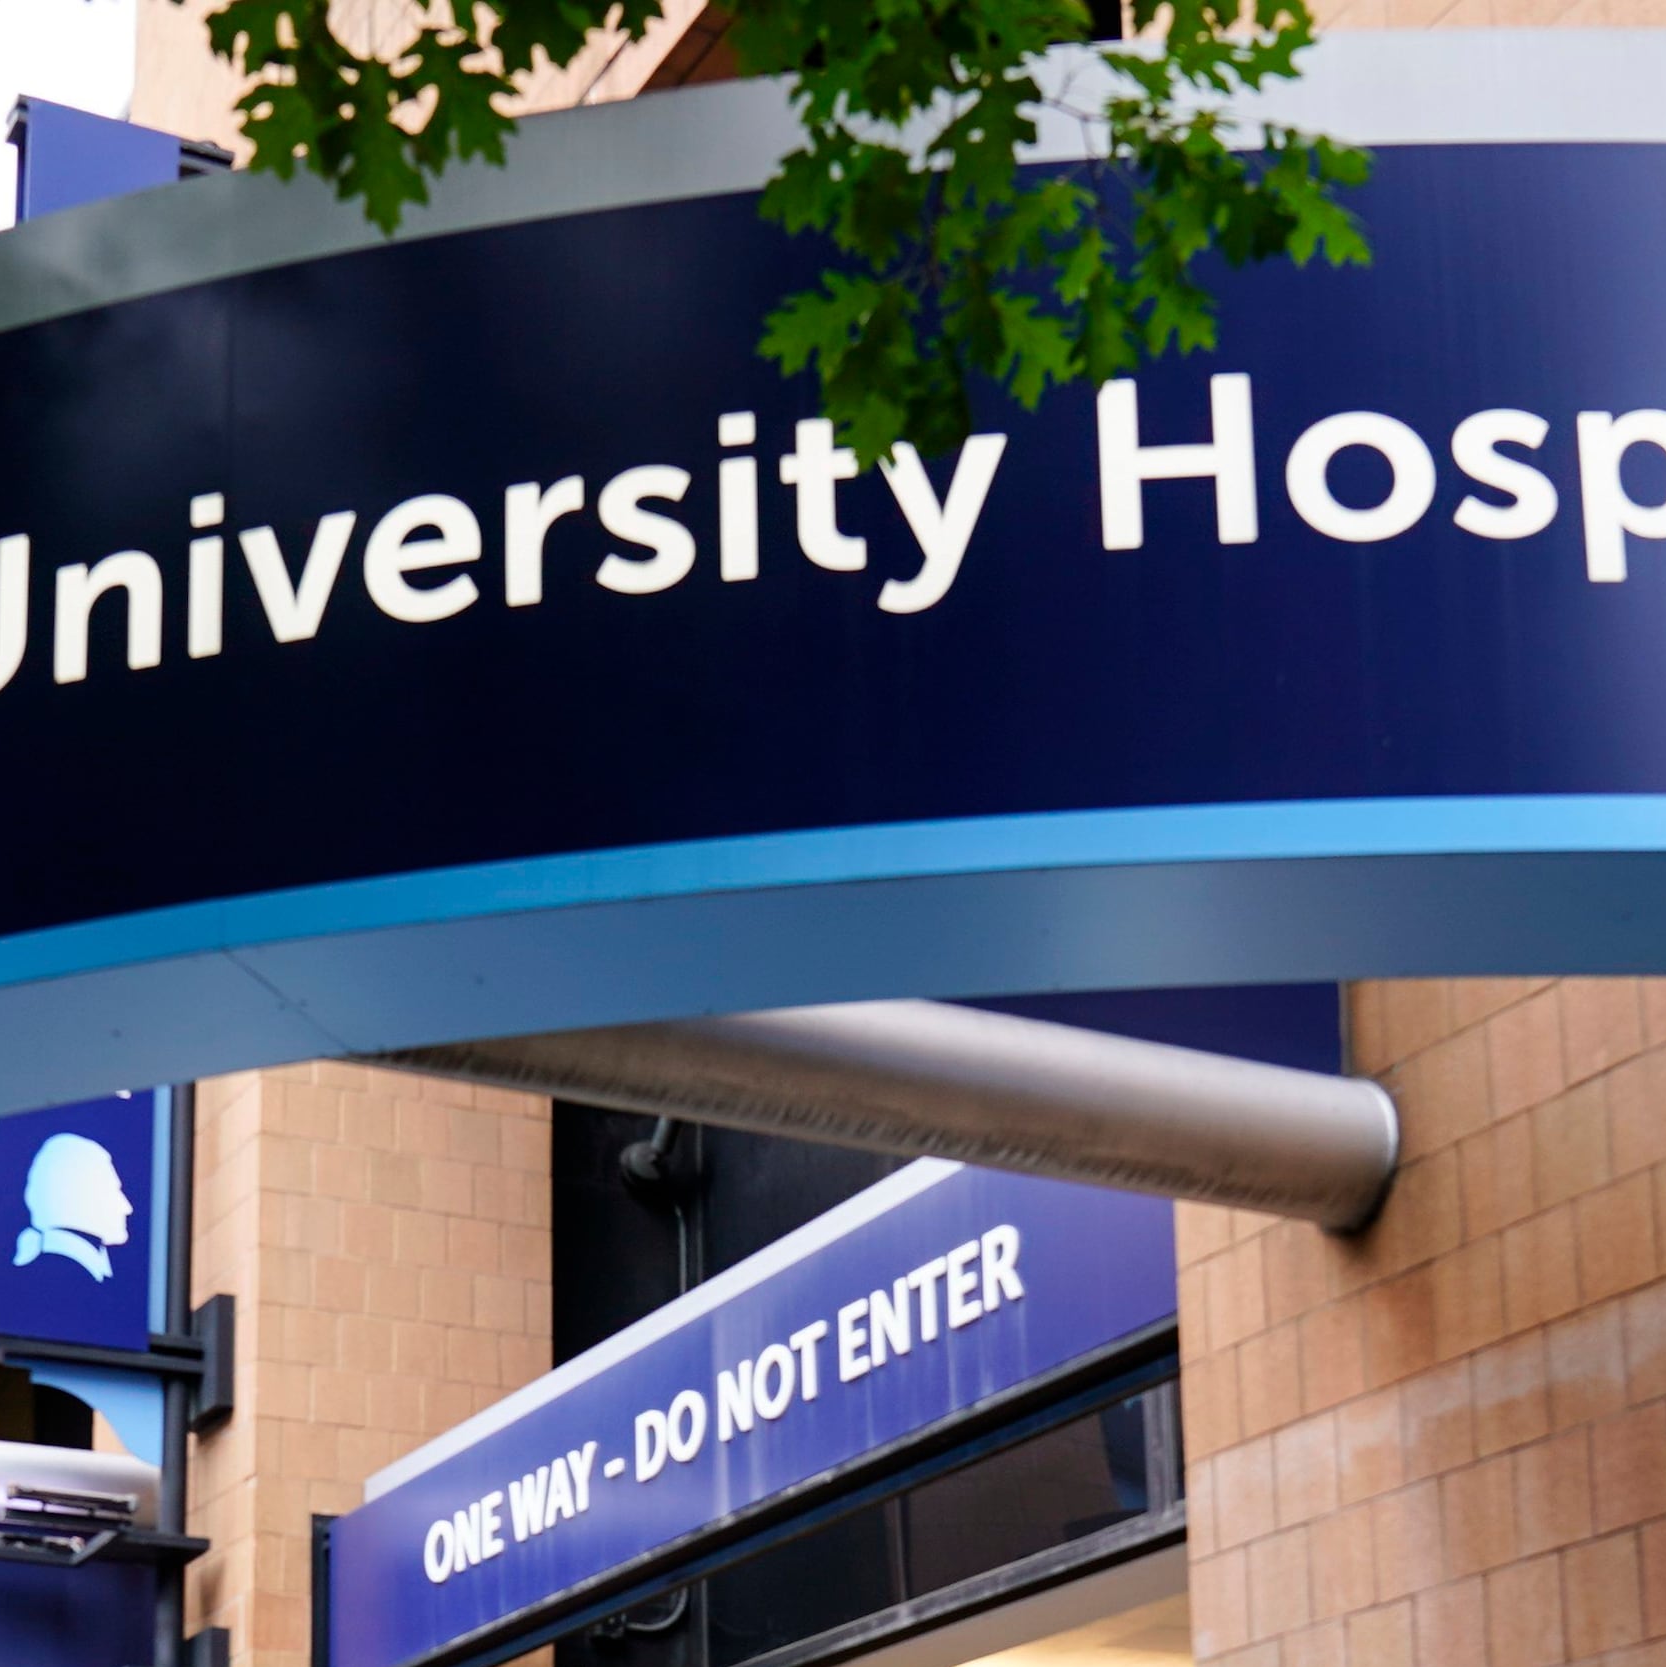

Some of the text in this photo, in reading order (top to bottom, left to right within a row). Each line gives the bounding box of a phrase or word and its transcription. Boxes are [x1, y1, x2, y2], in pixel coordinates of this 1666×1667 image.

[423, 1490, 505, 1584] ONE
[508, 1440, 598, 1544] WAY
[634, 1389, 708, 1484] DO
[716, 1319, 828, 1443] NOT
[837, 1223, 1025, 1383] ENTER
